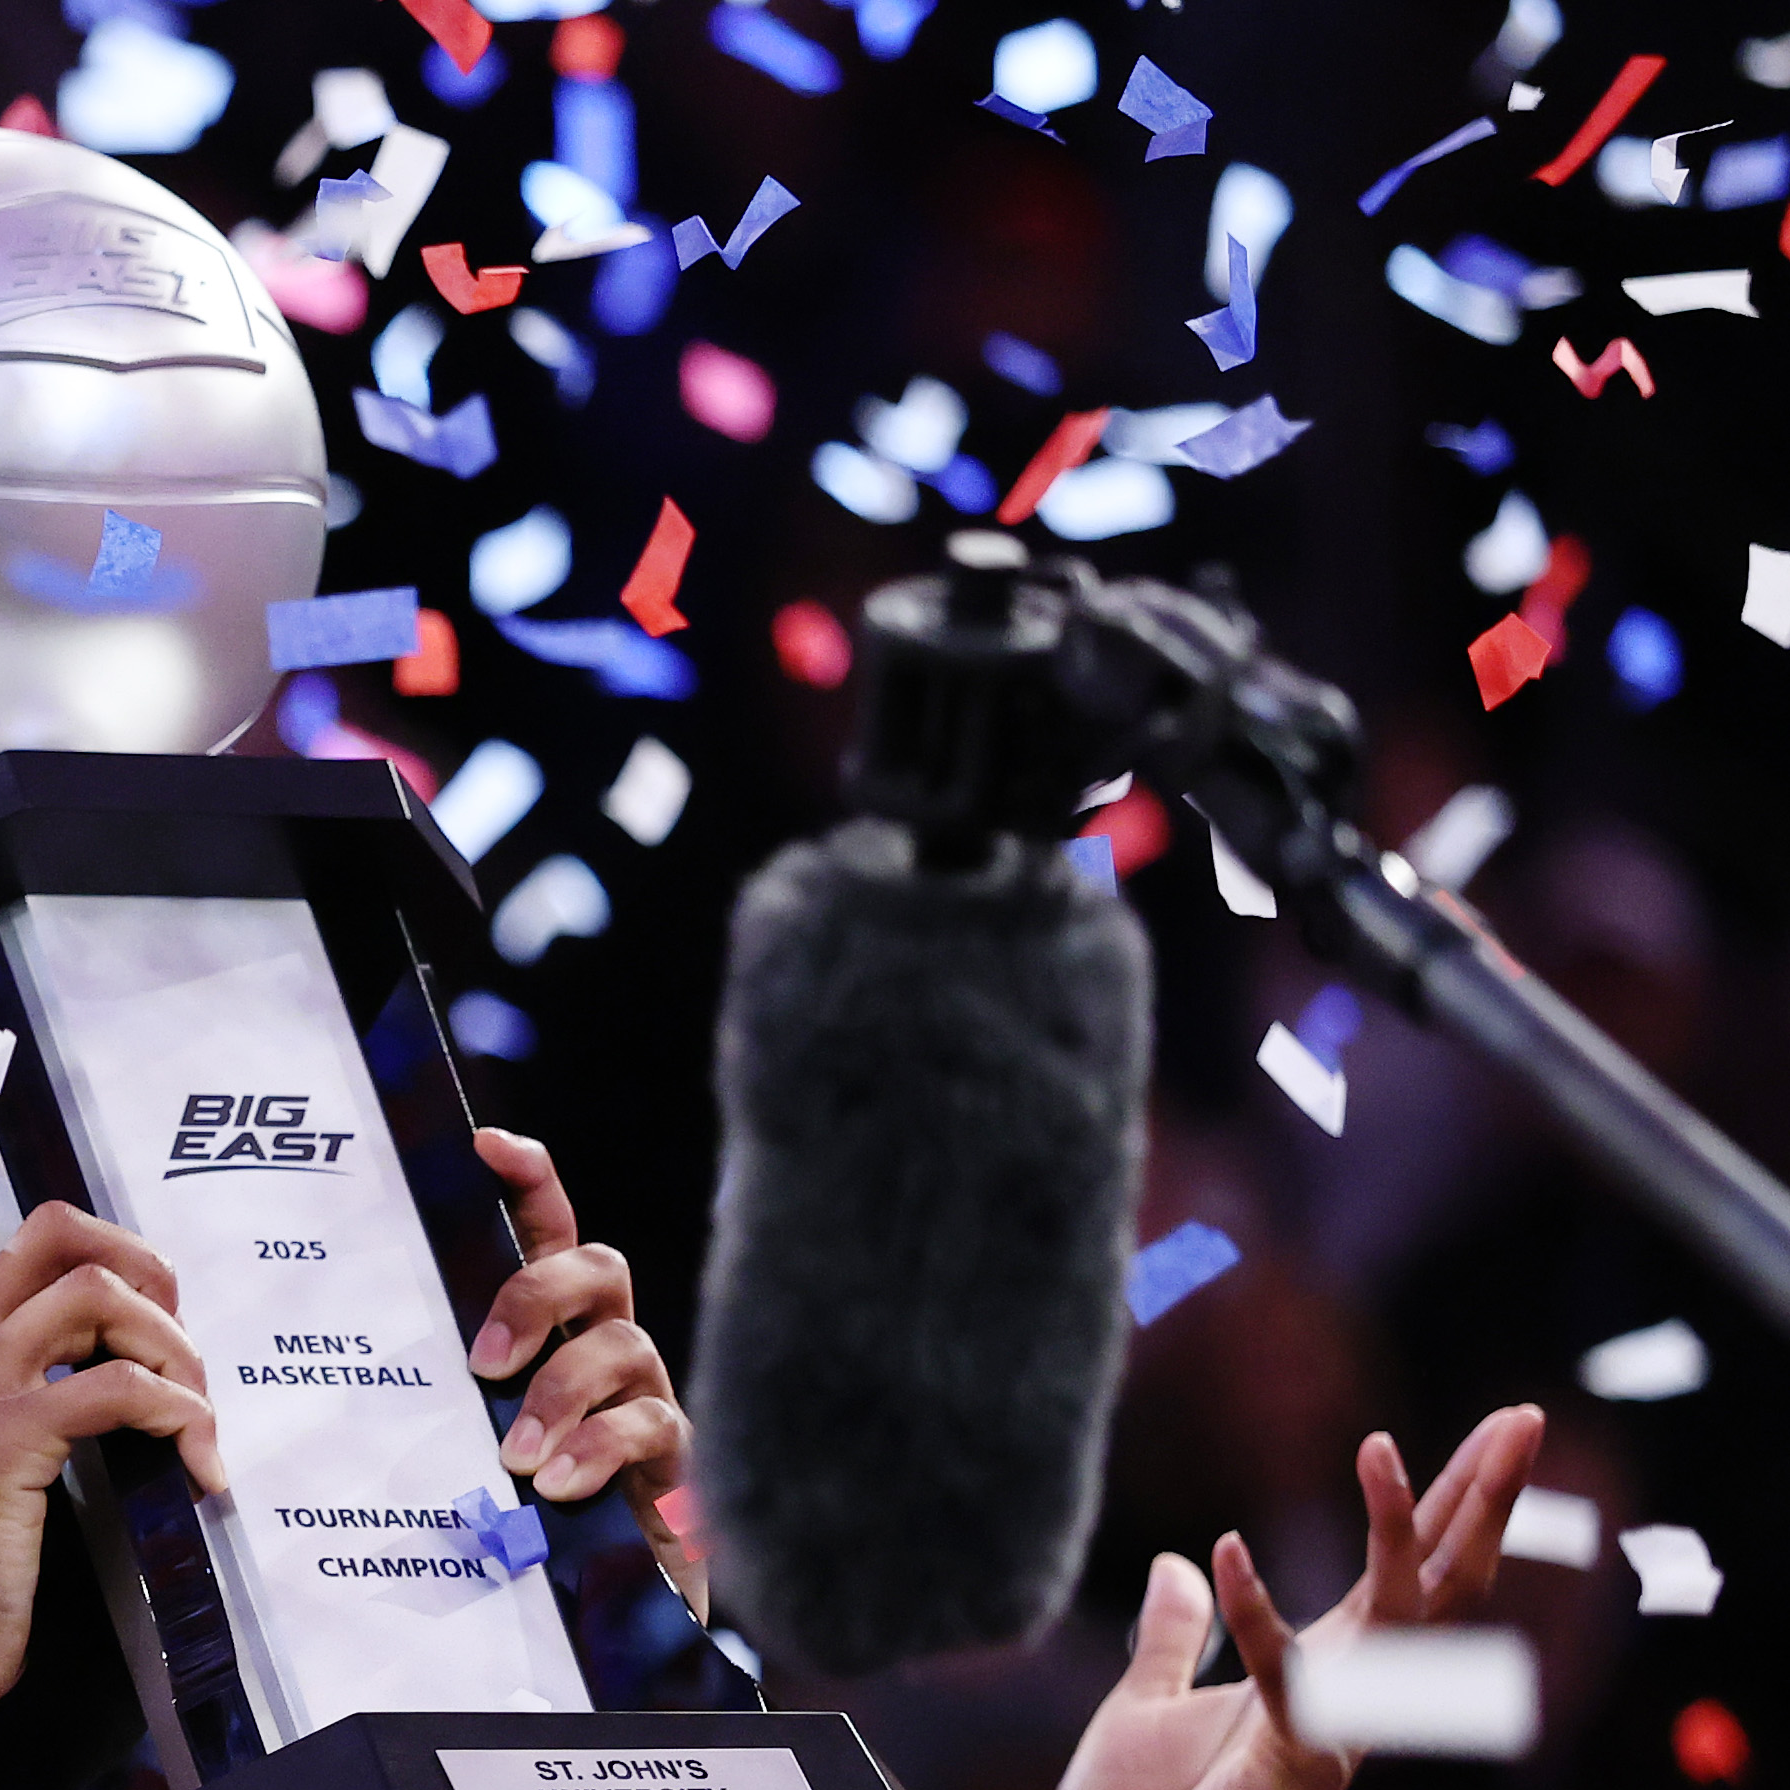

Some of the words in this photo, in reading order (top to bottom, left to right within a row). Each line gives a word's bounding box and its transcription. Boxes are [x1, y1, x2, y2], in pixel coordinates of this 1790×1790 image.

[180, 1094, 310, 1127] BIG
[169, 1131, 355, 1161] EAST
[254, 1241, 327, 1260] 2025
[274, 1335, 373, 1354] MEN'S
[237, 1366, 433, 1386] BASKETBALL
[274, 1508, 471, 1529] TOURNAMEN
[318, 1558, 487, 1578] CHAMPION
[534, 1761, 584, 1780] ST.
[592, 1760, 709, 1780] JOHN'S
